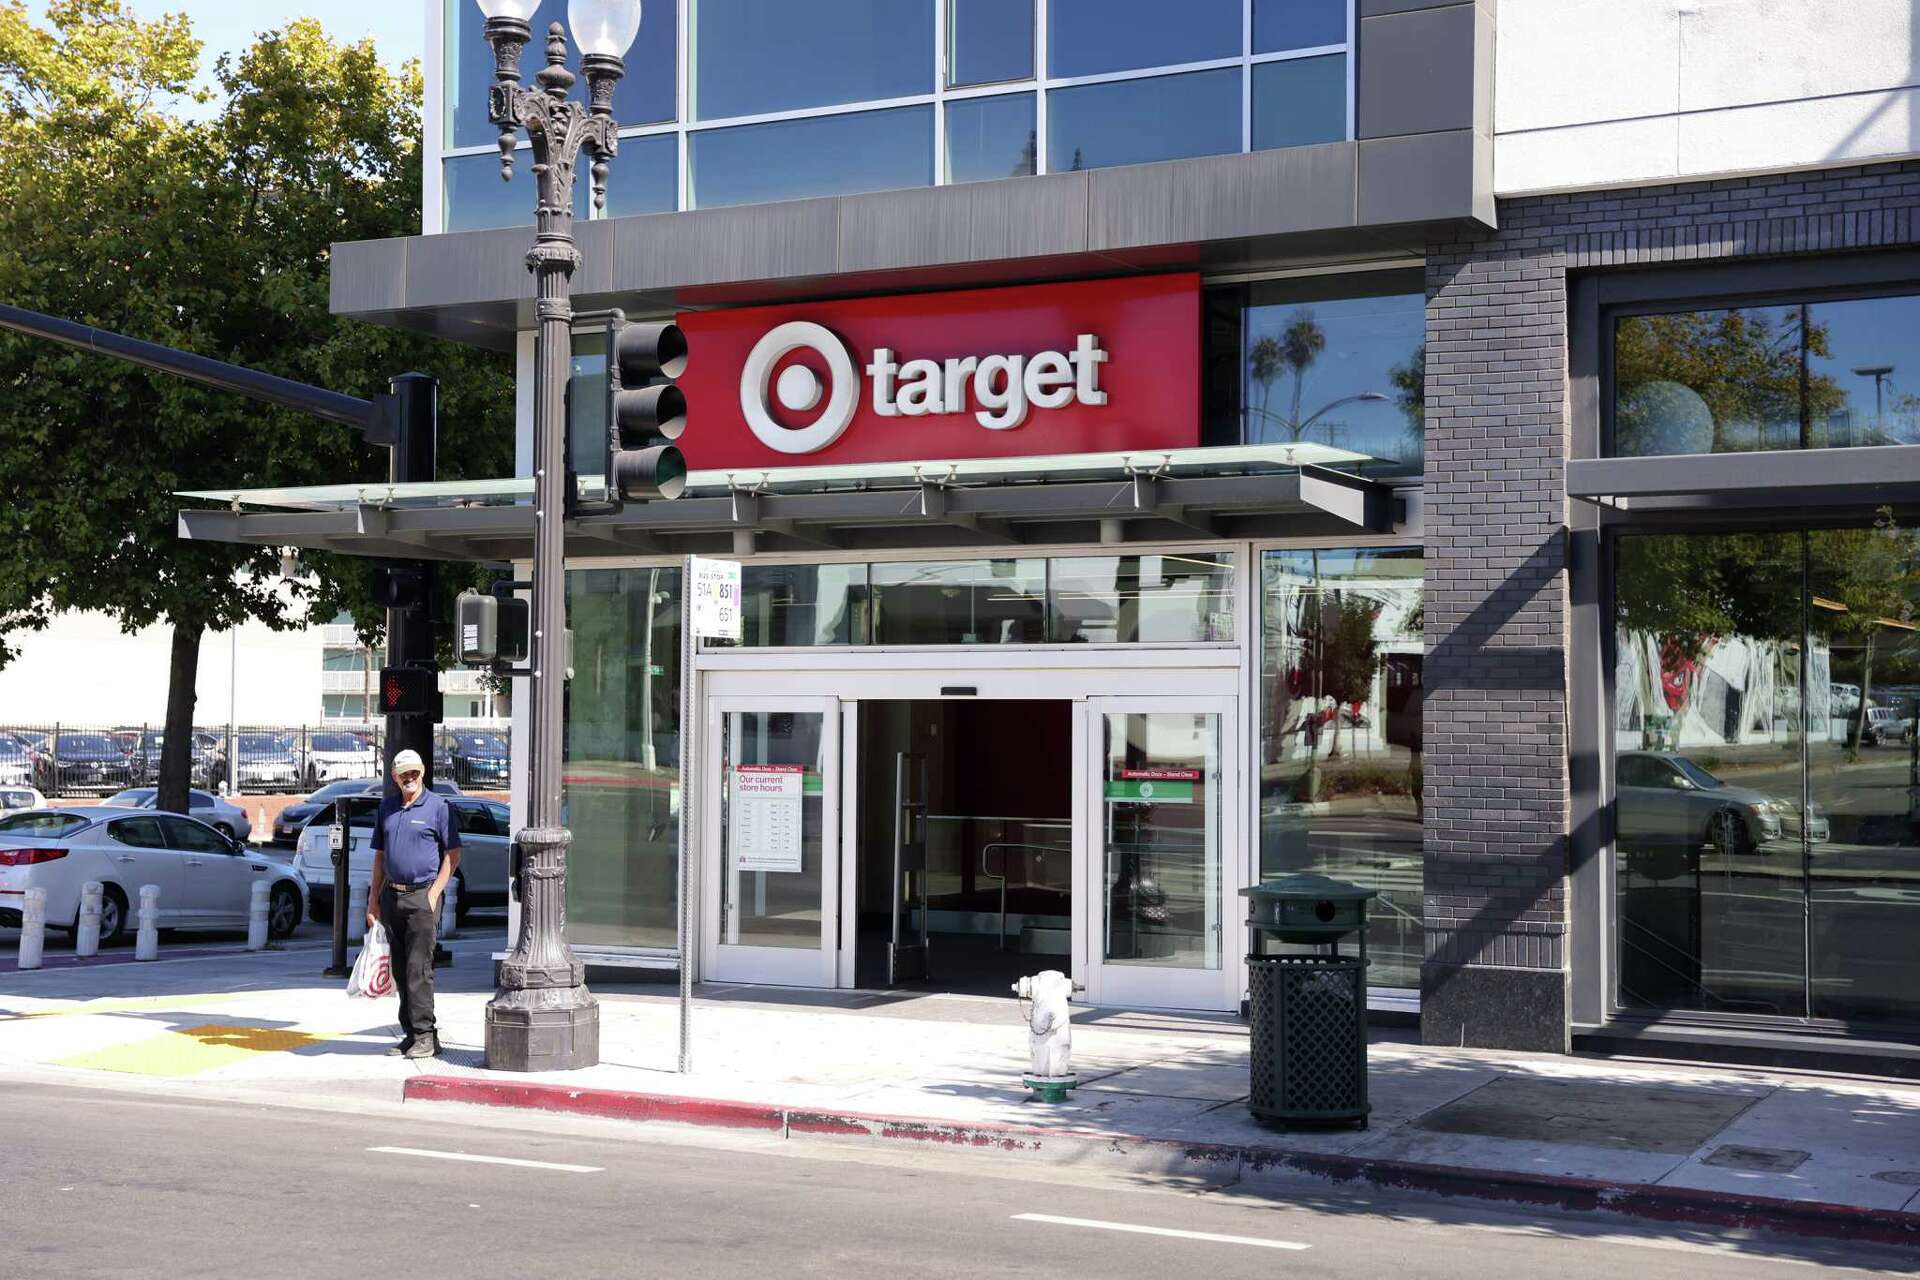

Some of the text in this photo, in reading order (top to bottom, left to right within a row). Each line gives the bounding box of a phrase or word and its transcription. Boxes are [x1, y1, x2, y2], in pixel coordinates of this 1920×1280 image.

[866, 334, 1109, 430] target
[697, 582, 712, 598] 51A
[719, 583, 733, 599] 851
[719, 607, 733, 623] 651
[740, 774, 783, 784] Our current
[739, 783, 783, 792] store hours
